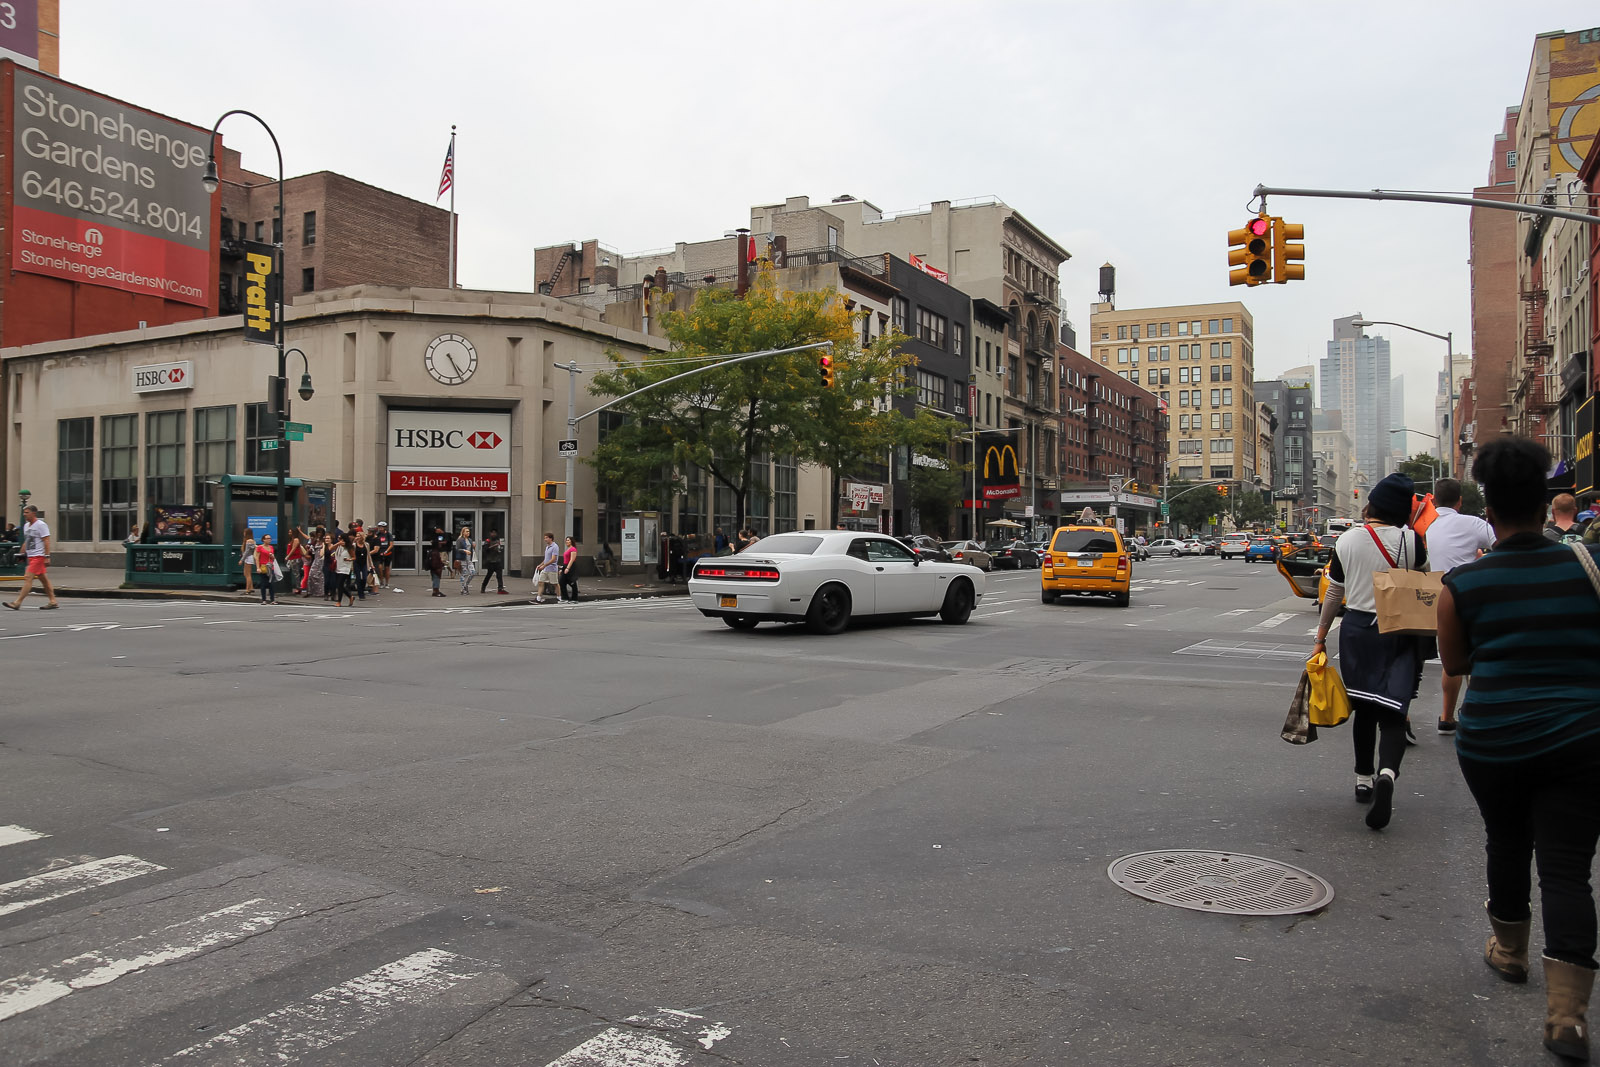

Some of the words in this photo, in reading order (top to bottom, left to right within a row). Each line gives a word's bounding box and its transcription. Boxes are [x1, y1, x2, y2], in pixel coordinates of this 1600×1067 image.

[0, 2, 17, 30] 3
[23, 85, 206, 169] Stonehenge
[21, 127, 156, 189] Gardens
[22, 170, 202, 240] 646.524.8014
[21, 229, 102, 259] Stonehenge
[21, 250, 202, 298] StonehengeGardensNYC.com
[246, 252, 272, 333] Pratt
[136, 369, 167, 387] HSBC
[394, 428, 464, 449] HSBC
[401, 475, 416, 487] 24
[418, 476, 448, 488] Hour
[451, 476, 498, 491] Banking
[986, 487, 1018, 496] McDonald's
[855, 500, 866, 510] $1
[162, 551, 184, 561] Subway
